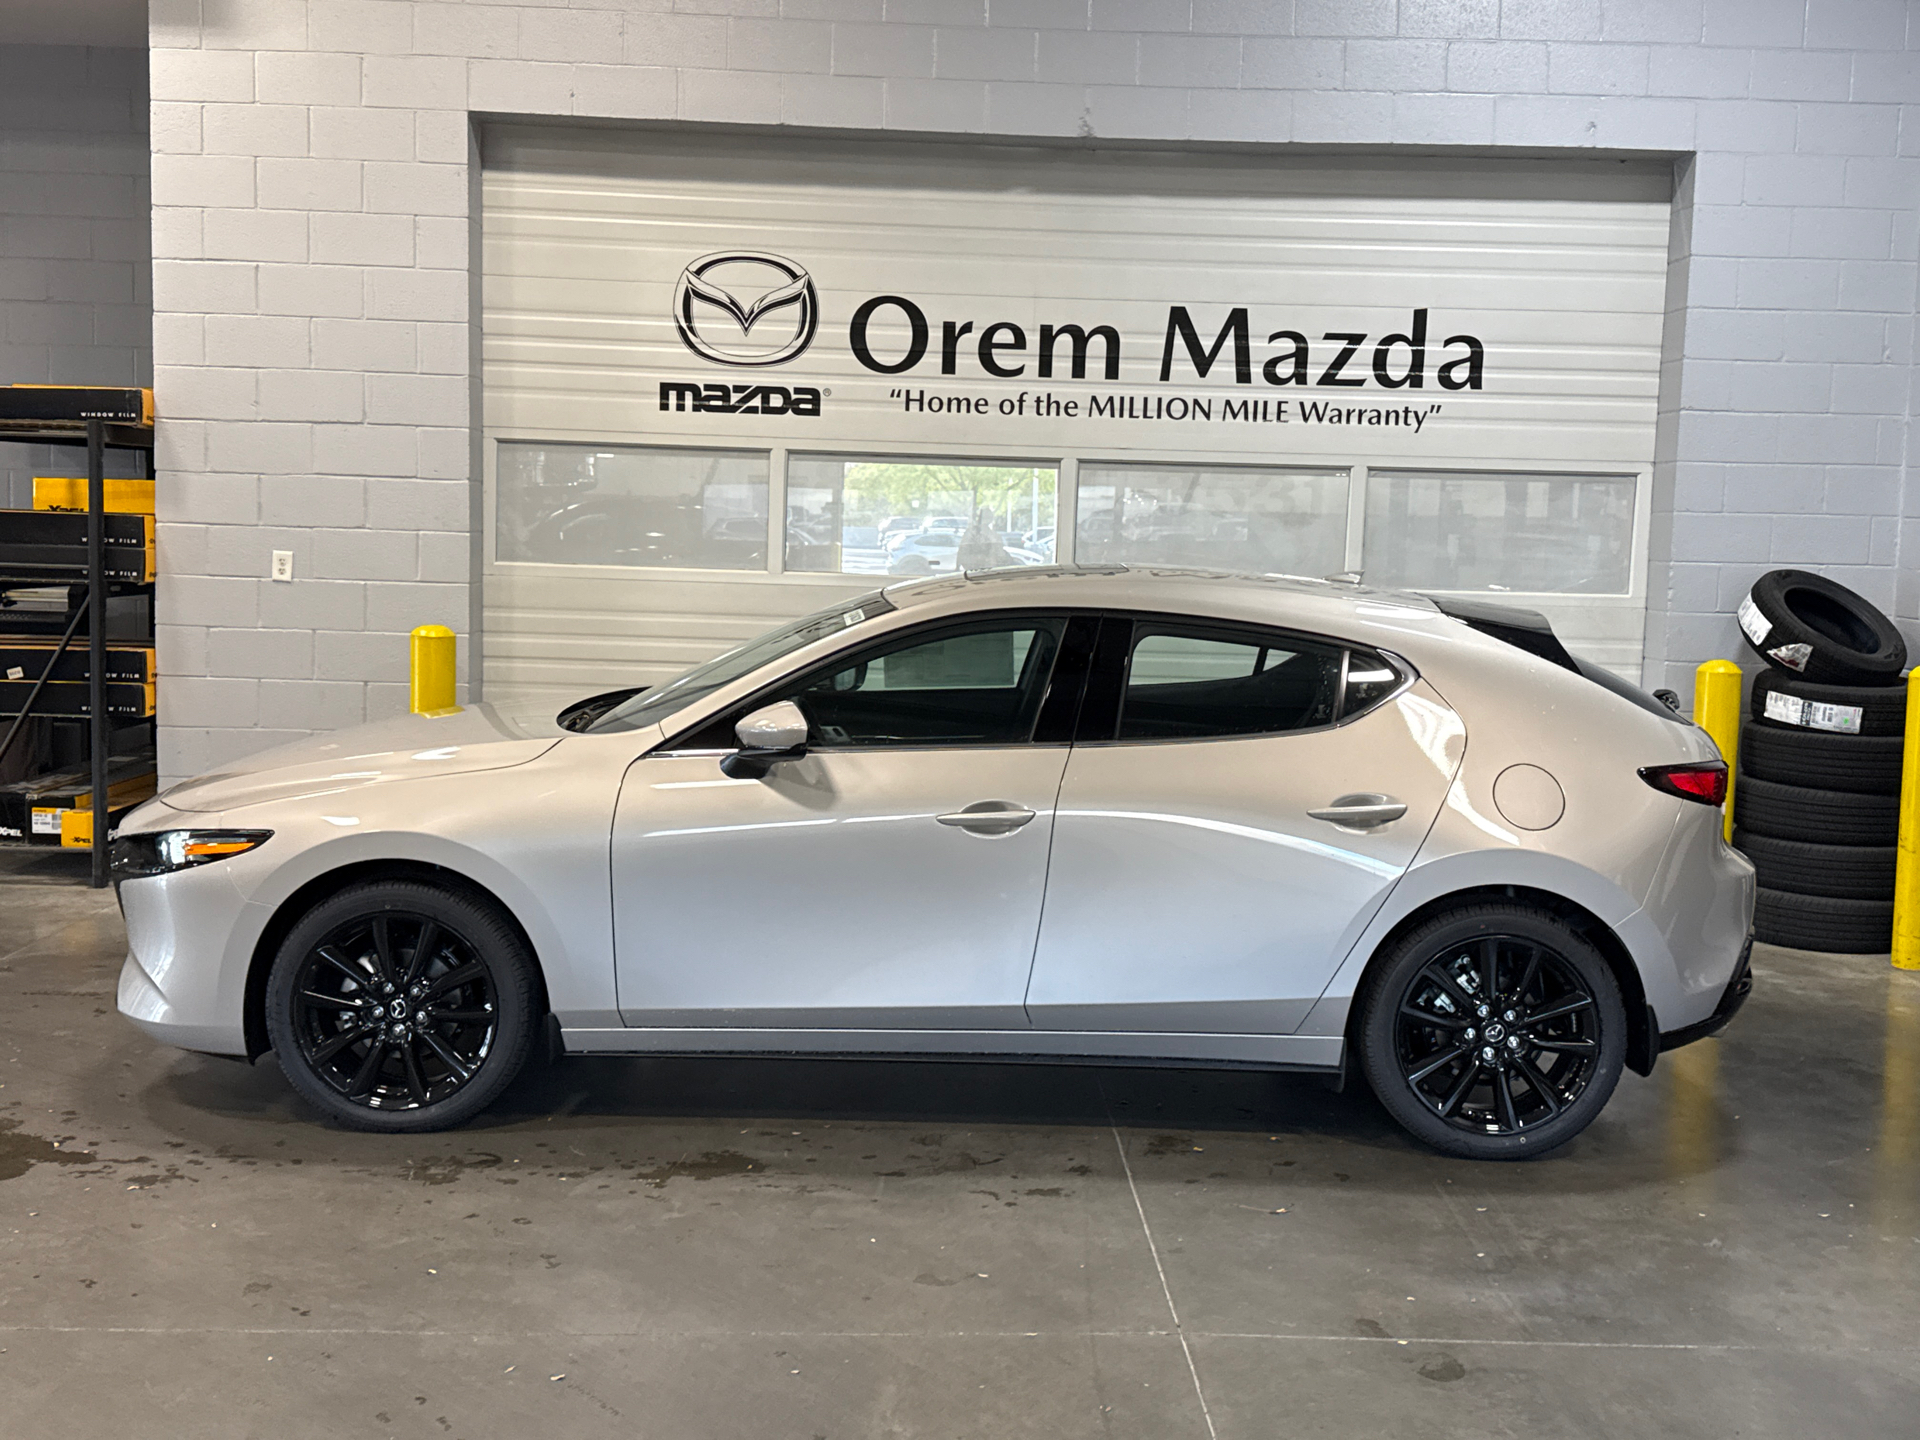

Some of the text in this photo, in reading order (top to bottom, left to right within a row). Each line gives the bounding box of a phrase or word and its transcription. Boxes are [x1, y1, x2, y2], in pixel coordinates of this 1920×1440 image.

[849, 294, 1484, 391] Orem Mazda
[889, 387, 1442, 434] “Home of the MILLION MILE Warranty”
